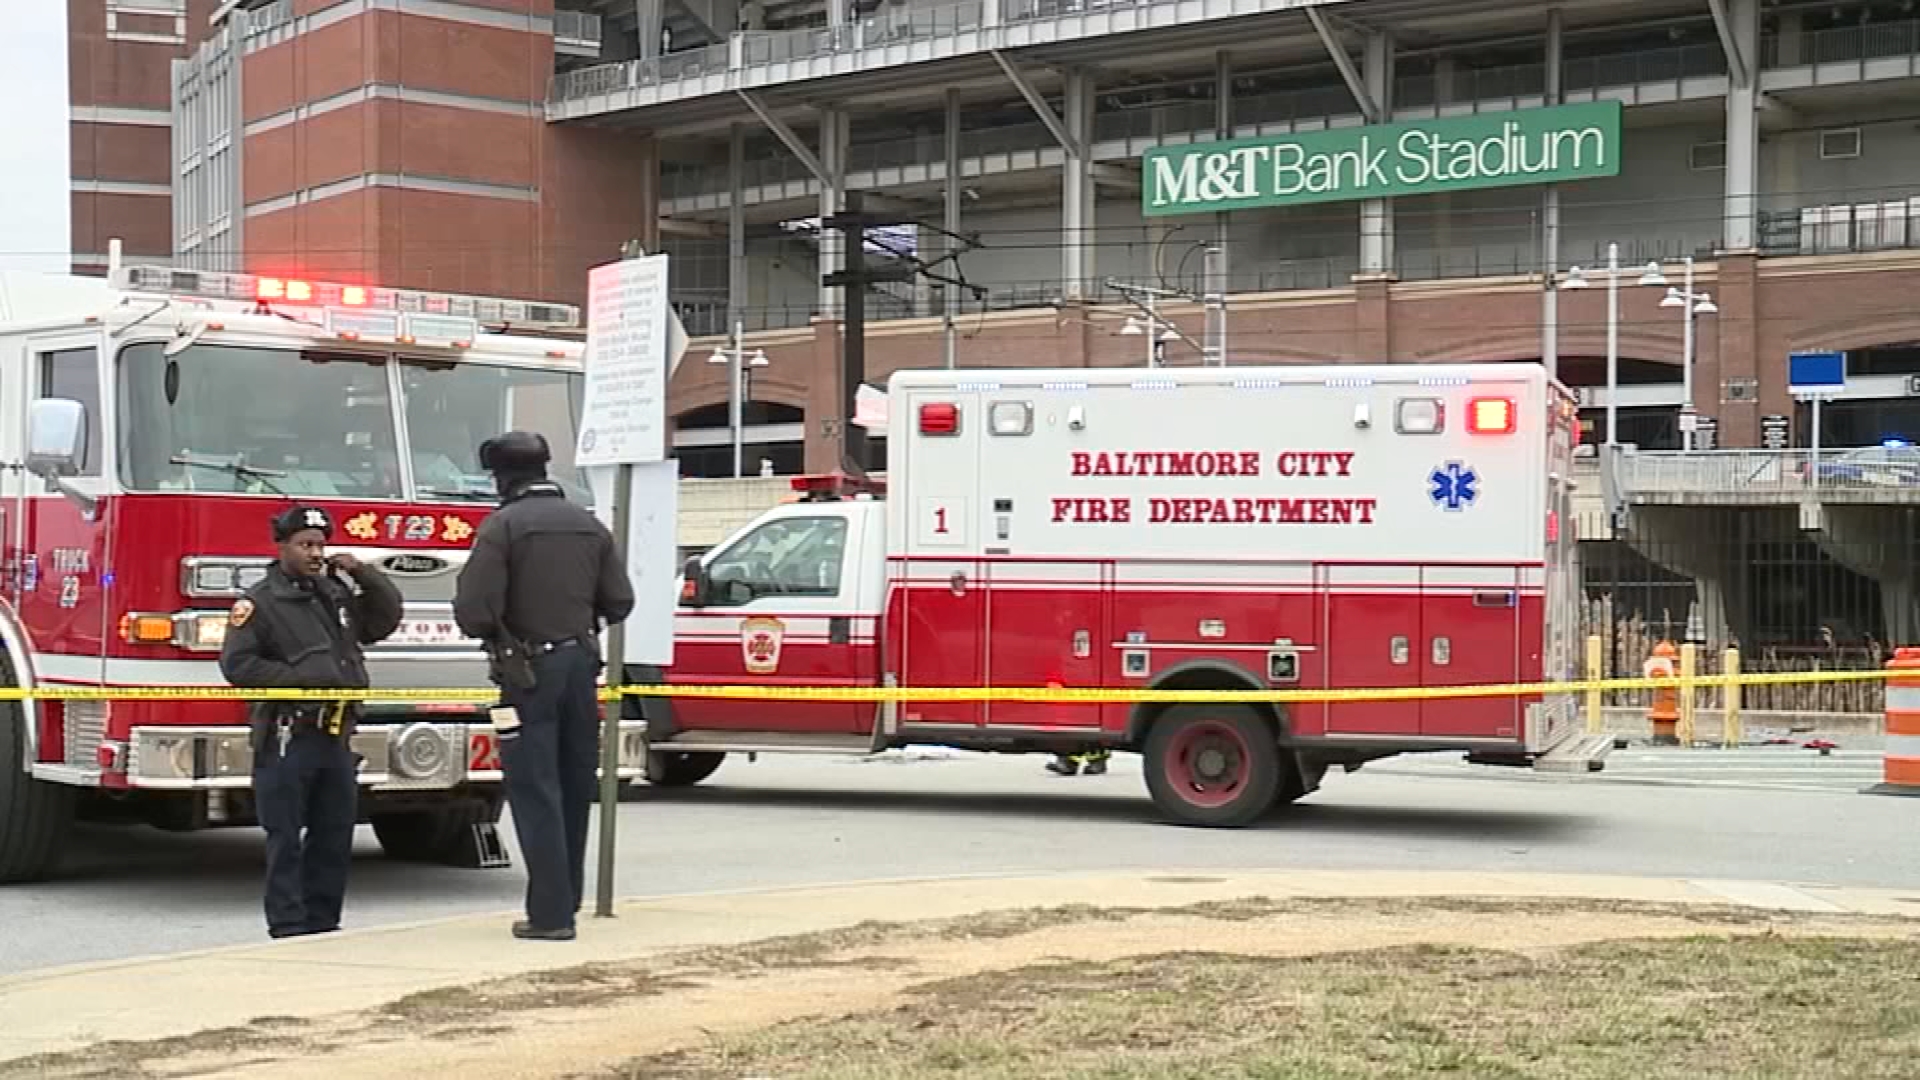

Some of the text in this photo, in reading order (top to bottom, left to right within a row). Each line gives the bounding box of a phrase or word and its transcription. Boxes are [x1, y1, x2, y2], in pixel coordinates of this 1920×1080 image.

[1151, 121, 1604, 206] M&T Bank Stadium
[1070, 452, 1355, 477] BALTIMORE CITY
[933, 508, 949, 534] 1
[1050, 498, 1377, 523] FIRE DEPARTMENT
[384, 514, 436, 541] T 23
[53, 548, 90, 573] TRUCK
[60, 575, 80, 608] 23
